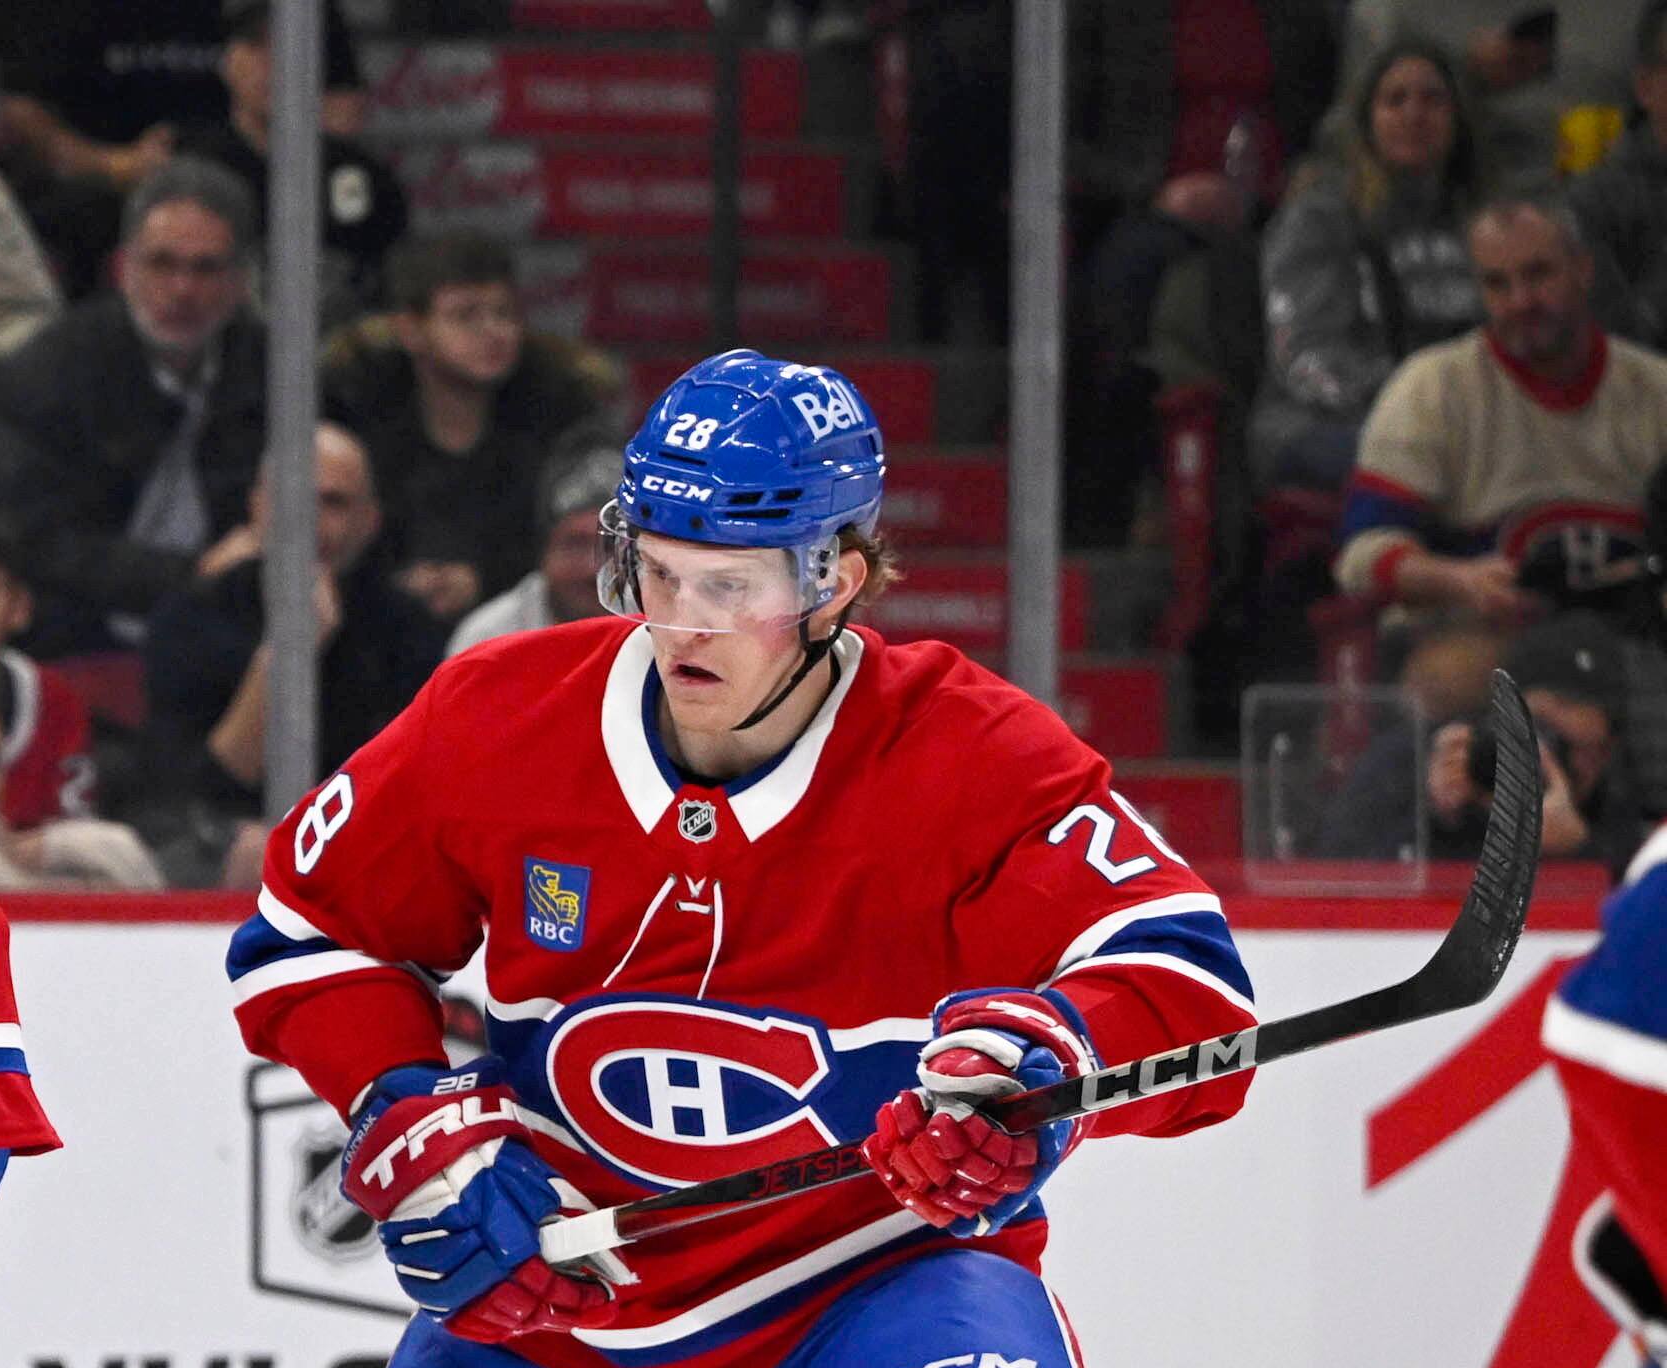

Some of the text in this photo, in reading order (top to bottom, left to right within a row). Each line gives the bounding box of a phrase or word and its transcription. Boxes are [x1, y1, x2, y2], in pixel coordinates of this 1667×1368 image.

[792, 380, 864, 441] Bell
[665, 412, 718, 451] 28
[641, 474, 715, 503] CCM
[283, 772, 354, 876] 8
[683, 807, 713, 834] LNH
[529, 915, 575, 946] RBC
[431, 1072, 479, 1097] 28
[1080, 1025, 1259, 1113] CCM
[359, 1095, 523, 1190] TRU
